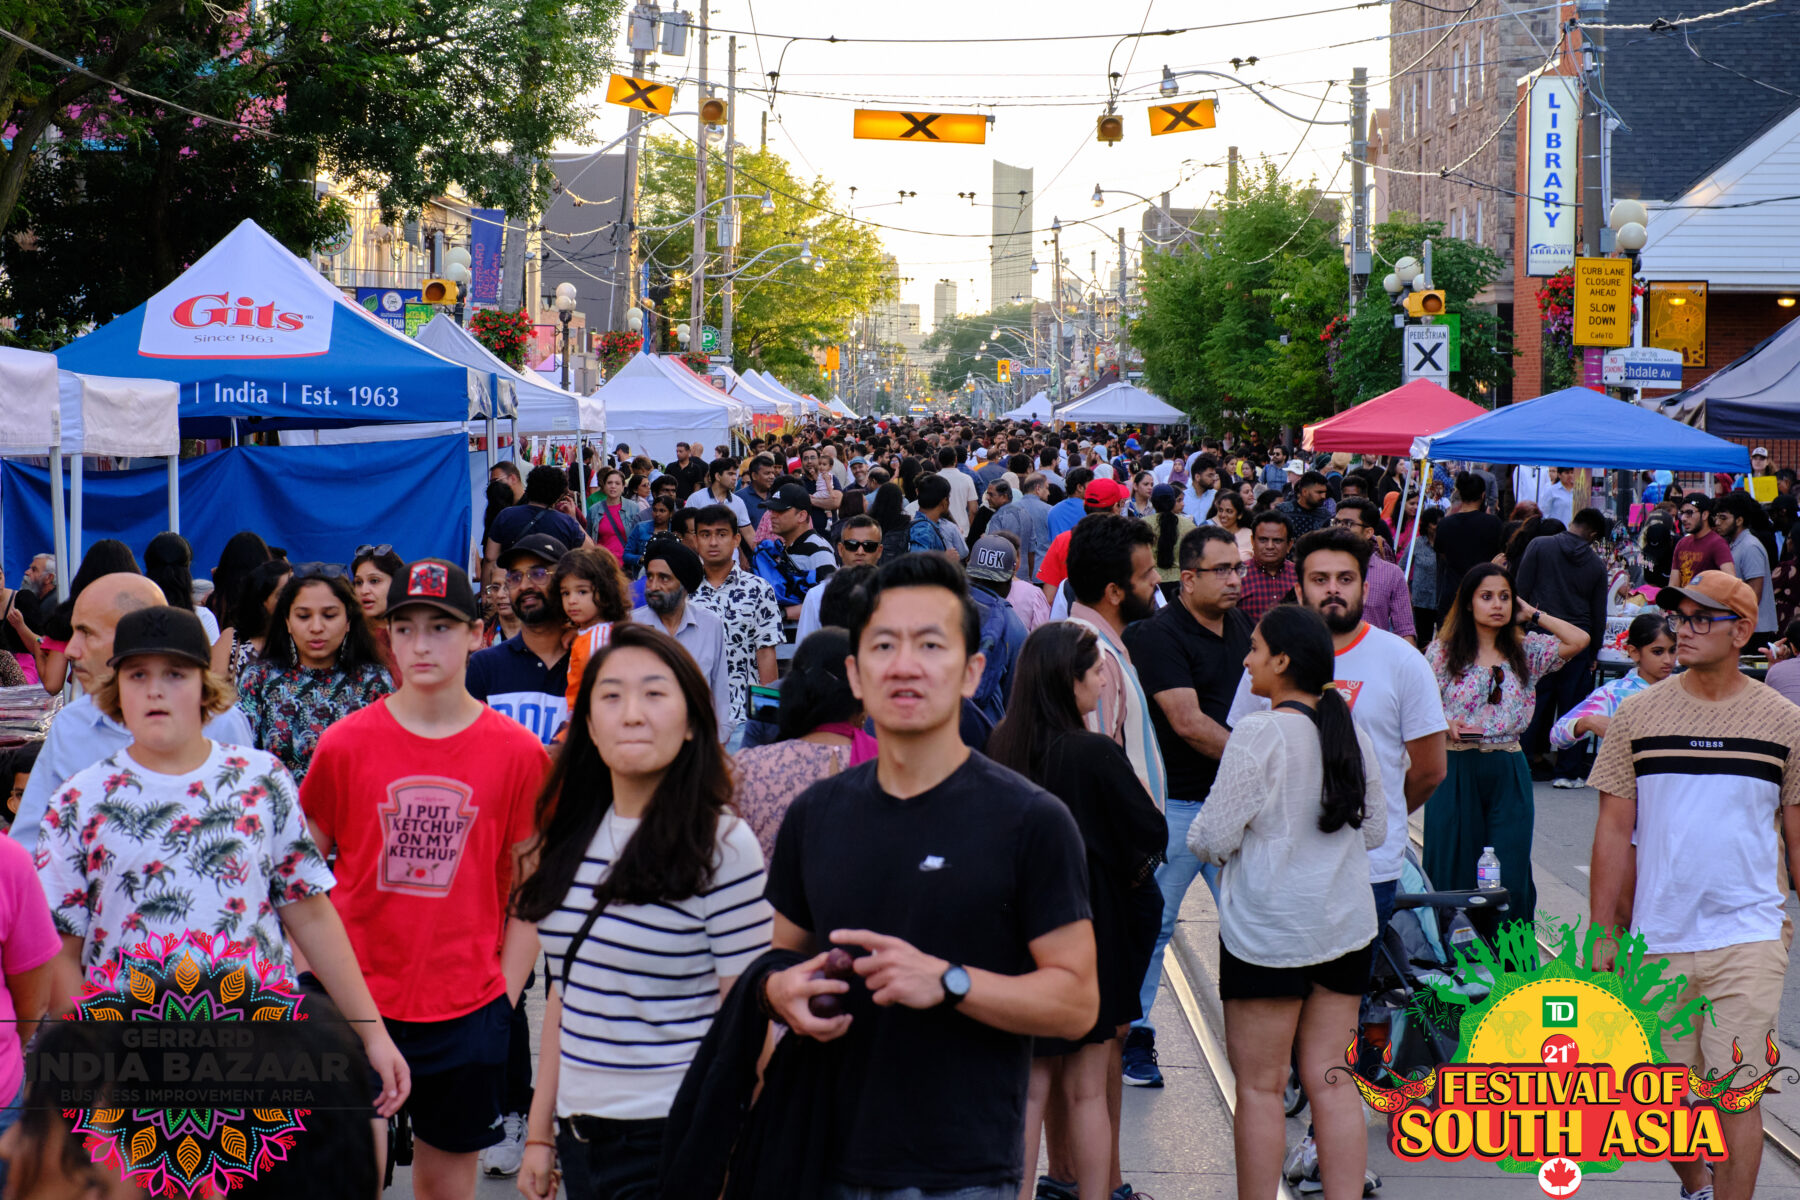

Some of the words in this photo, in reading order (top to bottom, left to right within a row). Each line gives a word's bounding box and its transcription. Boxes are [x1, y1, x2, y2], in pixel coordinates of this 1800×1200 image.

[1543, 93, 1562, 228] LIBRARY
[1582, 267, 1602, 275] CURB
[1605, 268, 1625, 276] LANE
[1585, 278, 1621, 286] CLOSURE
[171, 291, 304, 331] Gits
[1590, 303, 1616, 313] SLOW
[1589, 316, 1616, 326] DOWN
[194, 333, 235, 344] Since
[240, 333, 274, 343] 1963
[1409, 331, 1446, 339] PEDESTRIAN
[1624, 366, 1658, 378] shdale
[1660, 369, 1672, 379] Av
[215, 381, 268, 404] India
[302, 385, 338, 405] Est.
[349, 386, 399, 407] 1963
[977, 547, 1006, 569] DGK
[1690, 740, 1724, 748] GUESS
[407, 804, 412, 817] I
[417, 805, 450, 819] PUT
[392, 818, 464, 834] KETCHUP
[398, 832, 421, 846] ON
[426, 834, 453, 847] MY
[389, 845, 457, 861] KETCHUP
